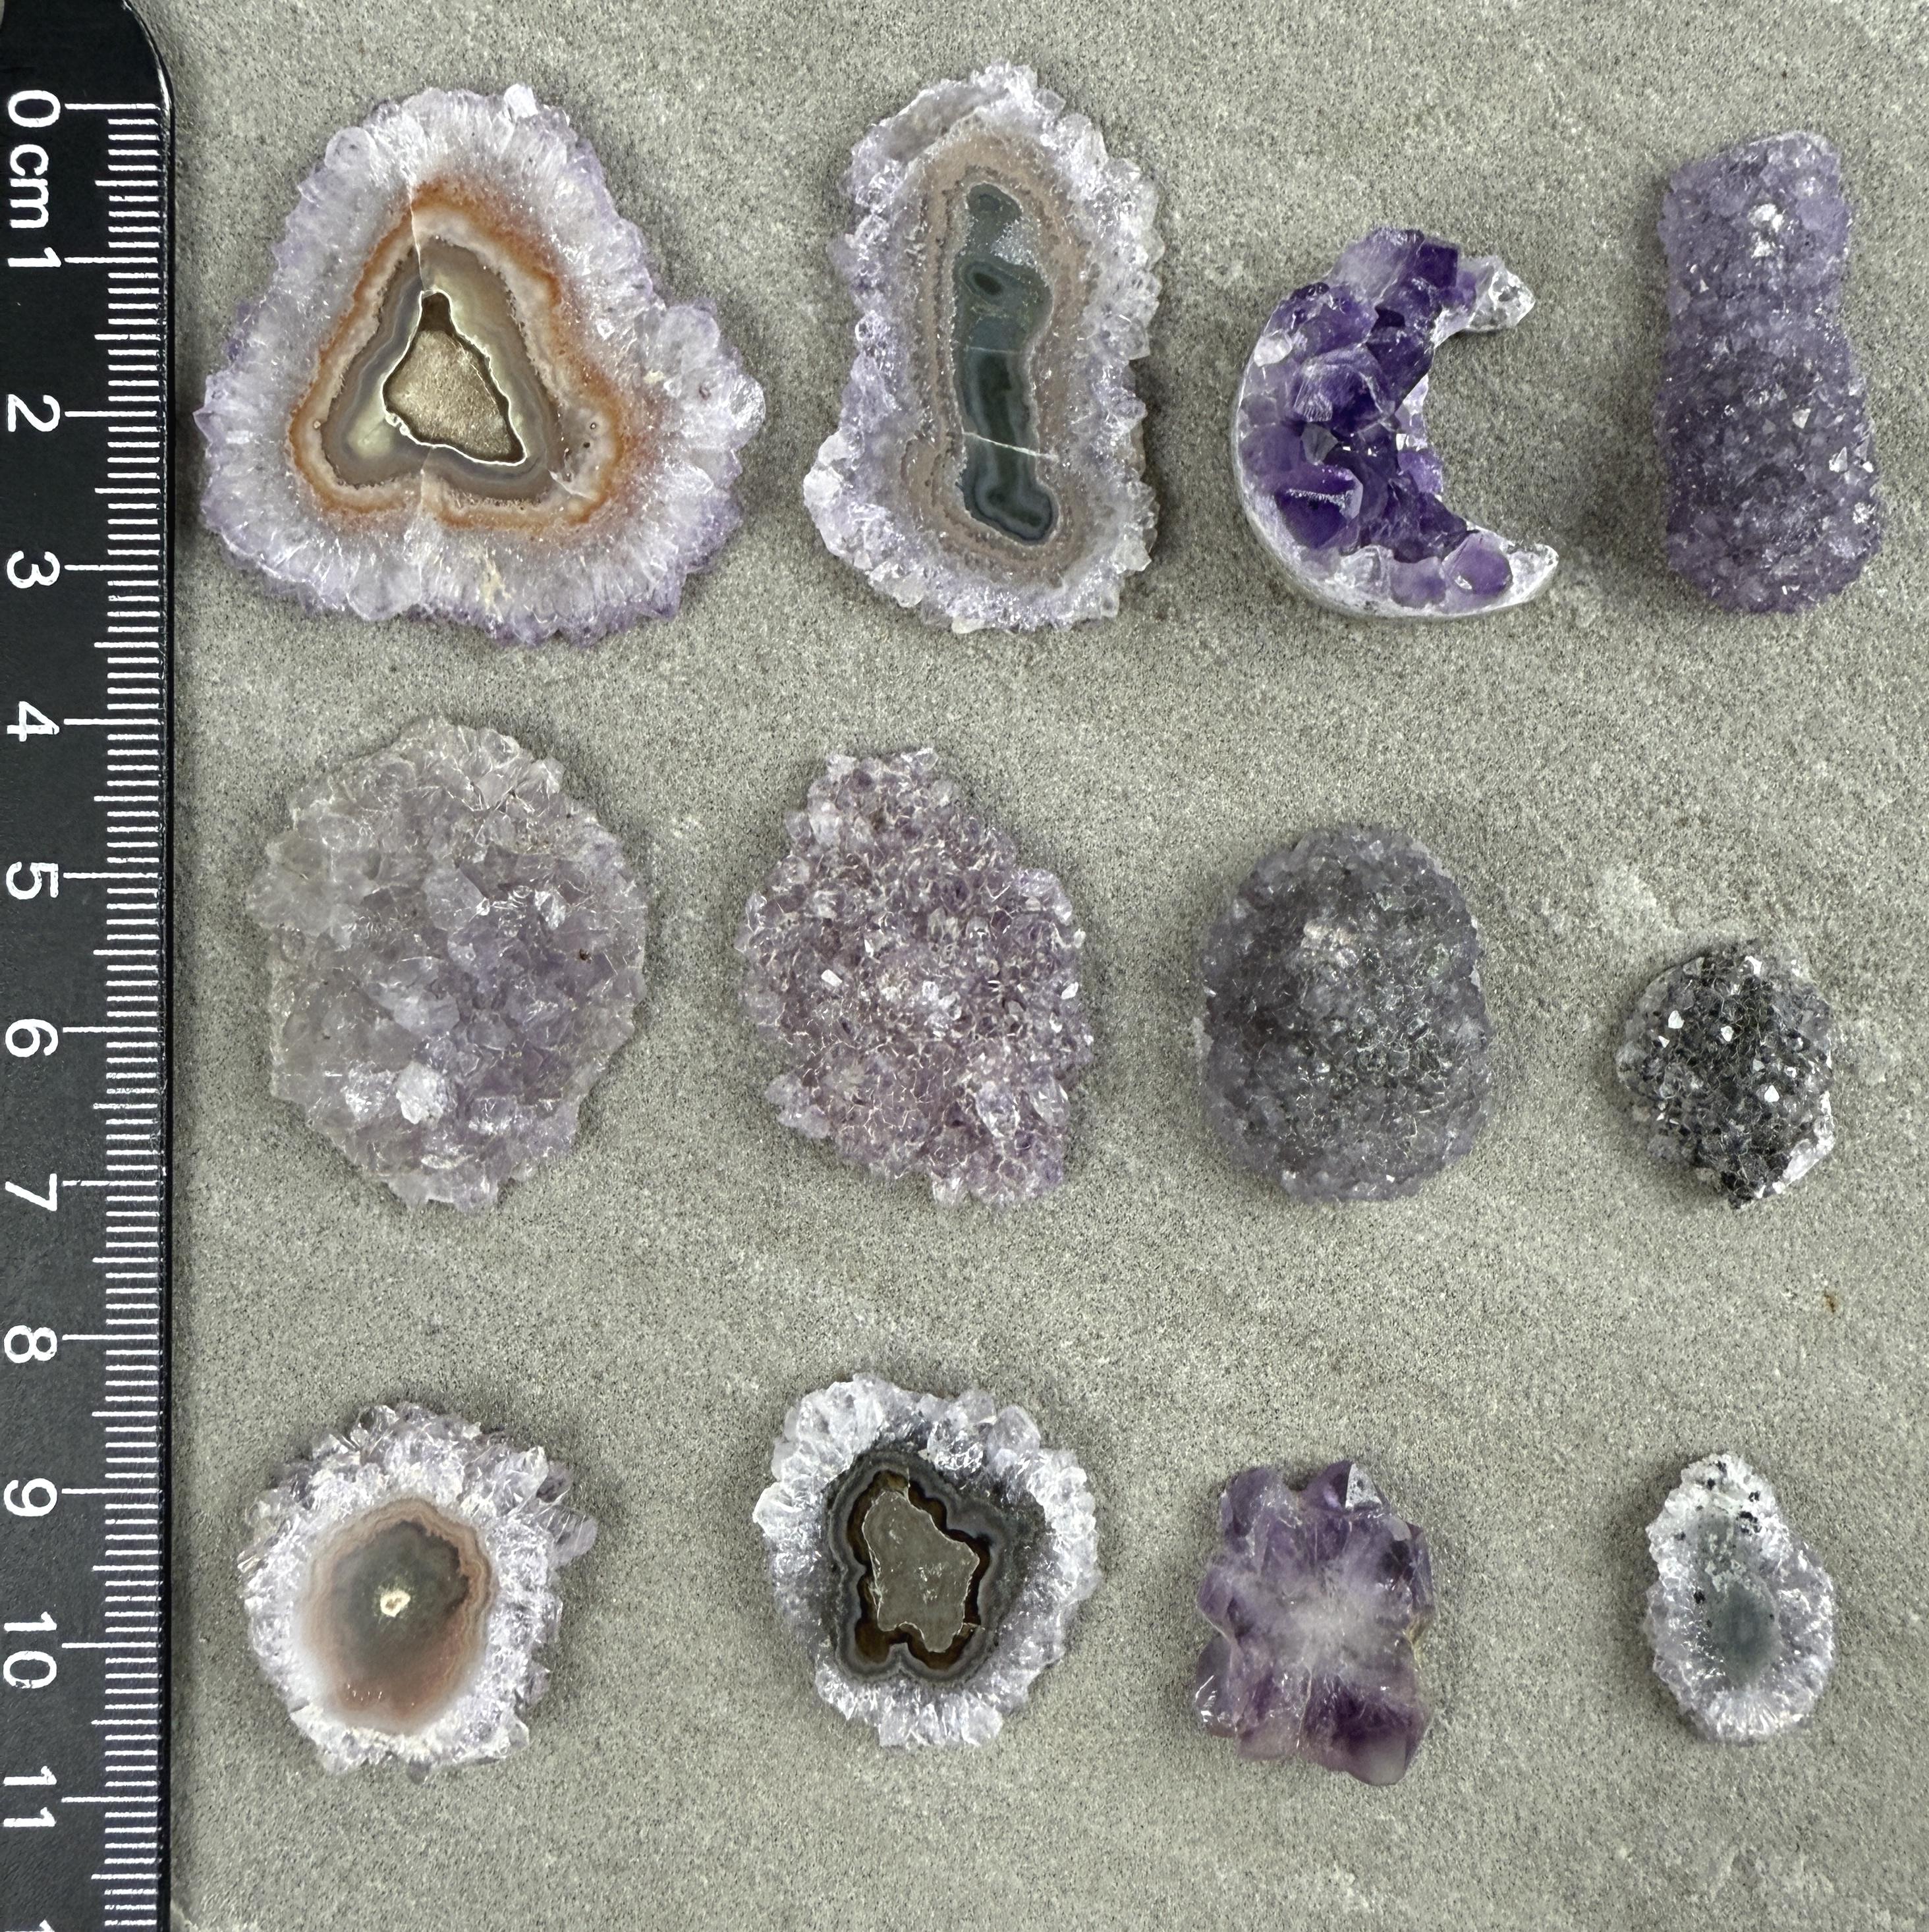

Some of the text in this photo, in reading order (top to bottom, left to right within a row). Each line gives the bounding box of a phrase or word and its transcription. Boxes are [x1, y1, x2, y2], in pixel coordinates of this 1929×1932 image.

[7, 246, 62, 267] 1
[7, 393, 61, 432] 2
[6, 550, 61, 589] 3
[6, 701, 60, 742] 4
[5, 861, 59, 900] 5
[5, 1018, 59, 1058] 6
[5, 1173, 58, 1212] 7
[3, 1325, 58, 1364] 8
[3, 1477, 58, 1517] 9
[3, 1611, 58, 1690] 10
[3, 1765, 57, 1828] 11
